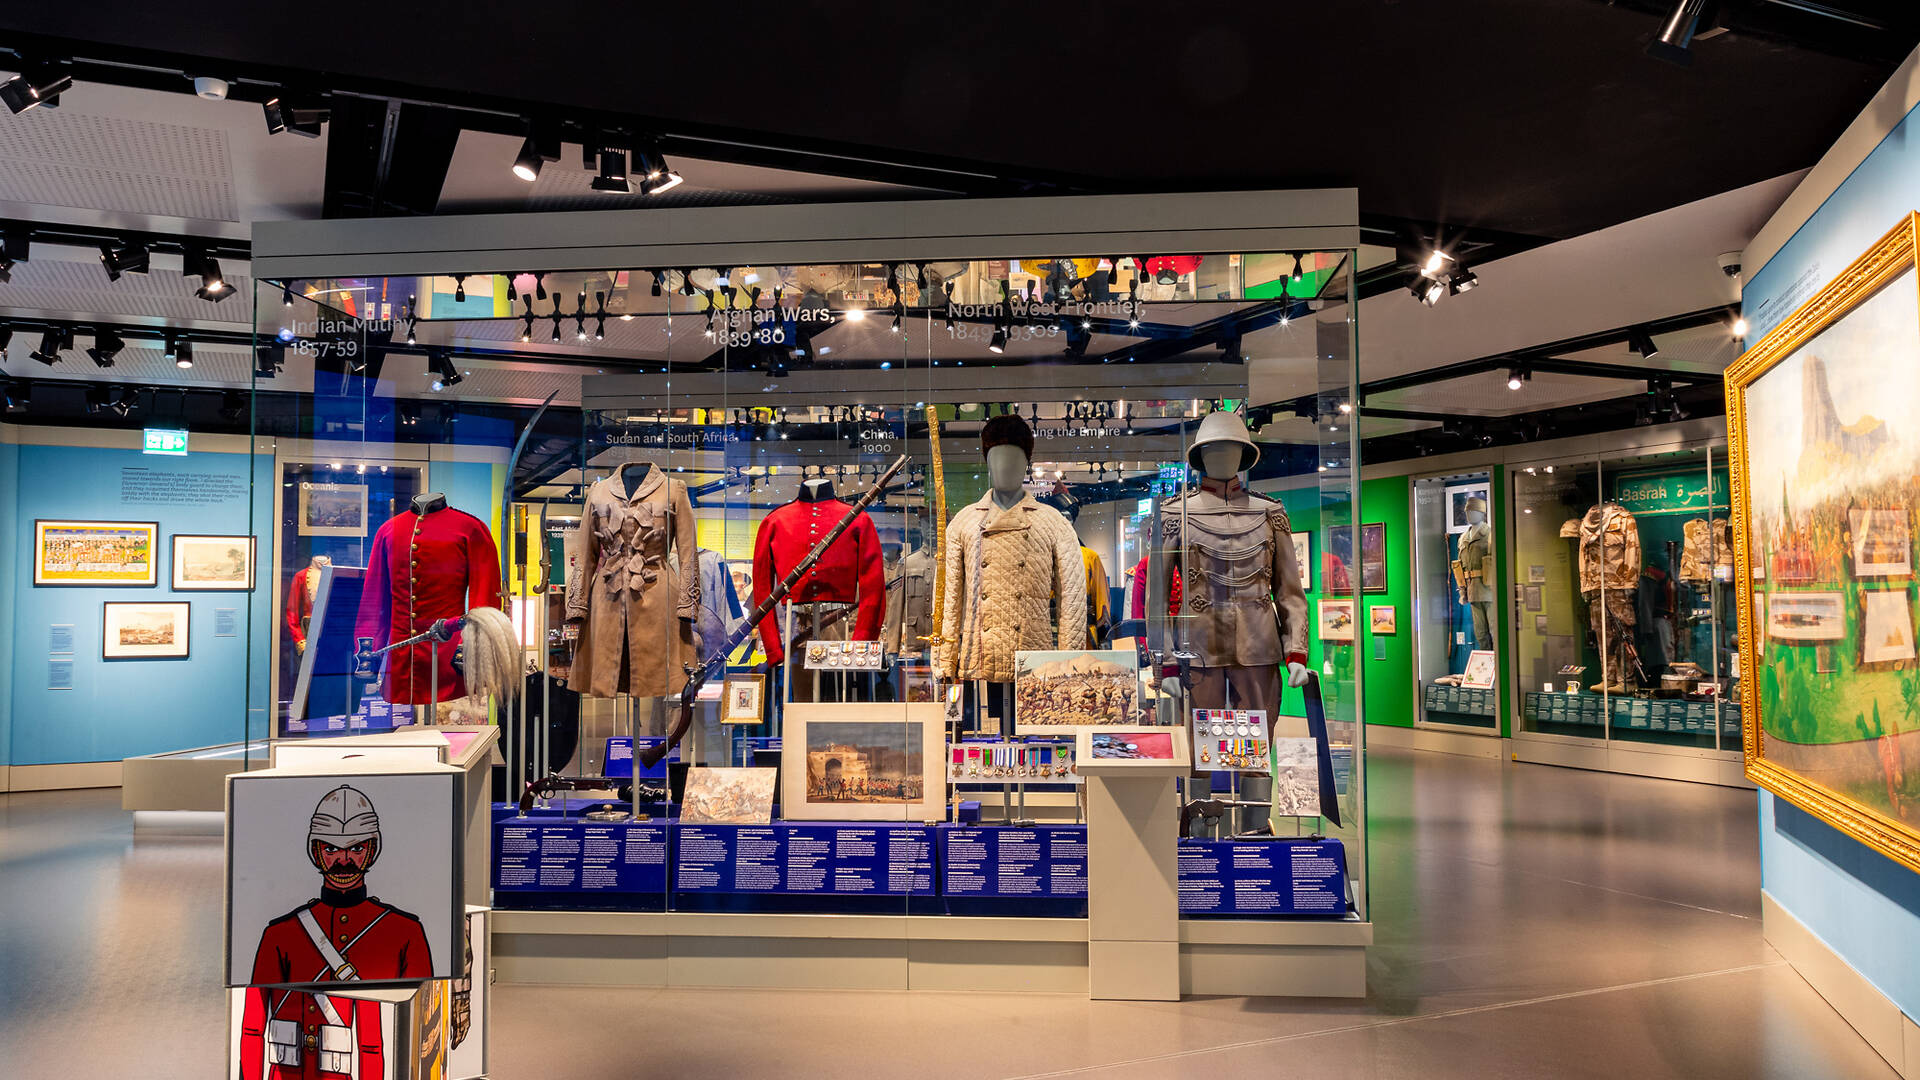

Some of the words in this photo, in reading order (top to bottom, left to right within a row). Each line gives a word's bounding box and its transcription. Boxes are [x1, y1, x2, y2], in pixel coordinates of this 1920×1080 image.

[948, 302, 1003, 319] North
[1010, 301, 1060, 318] West
[1065, 298, 1147, 317] Frontier,
[710, 306, 775, 328] Afghan
[782, 306, 836, 324] Wars,
[292, 317, 346, 334] Indian
[710, 327, 785, 348] 1839-80
[291, 339, 358, 358] 1857-59
[605, 433, 640, 445] Sudan
[643, 432, 664, 444] and
[668, 432, 699, 443] South
[863, 429, 899, 440] China,
[1057, 425, 1076, 437] the
[1079, 425, 1121, 439] Empire
[862, 444, 892, 455] 1900
[1622, 486, 1668, 502] Basrah
